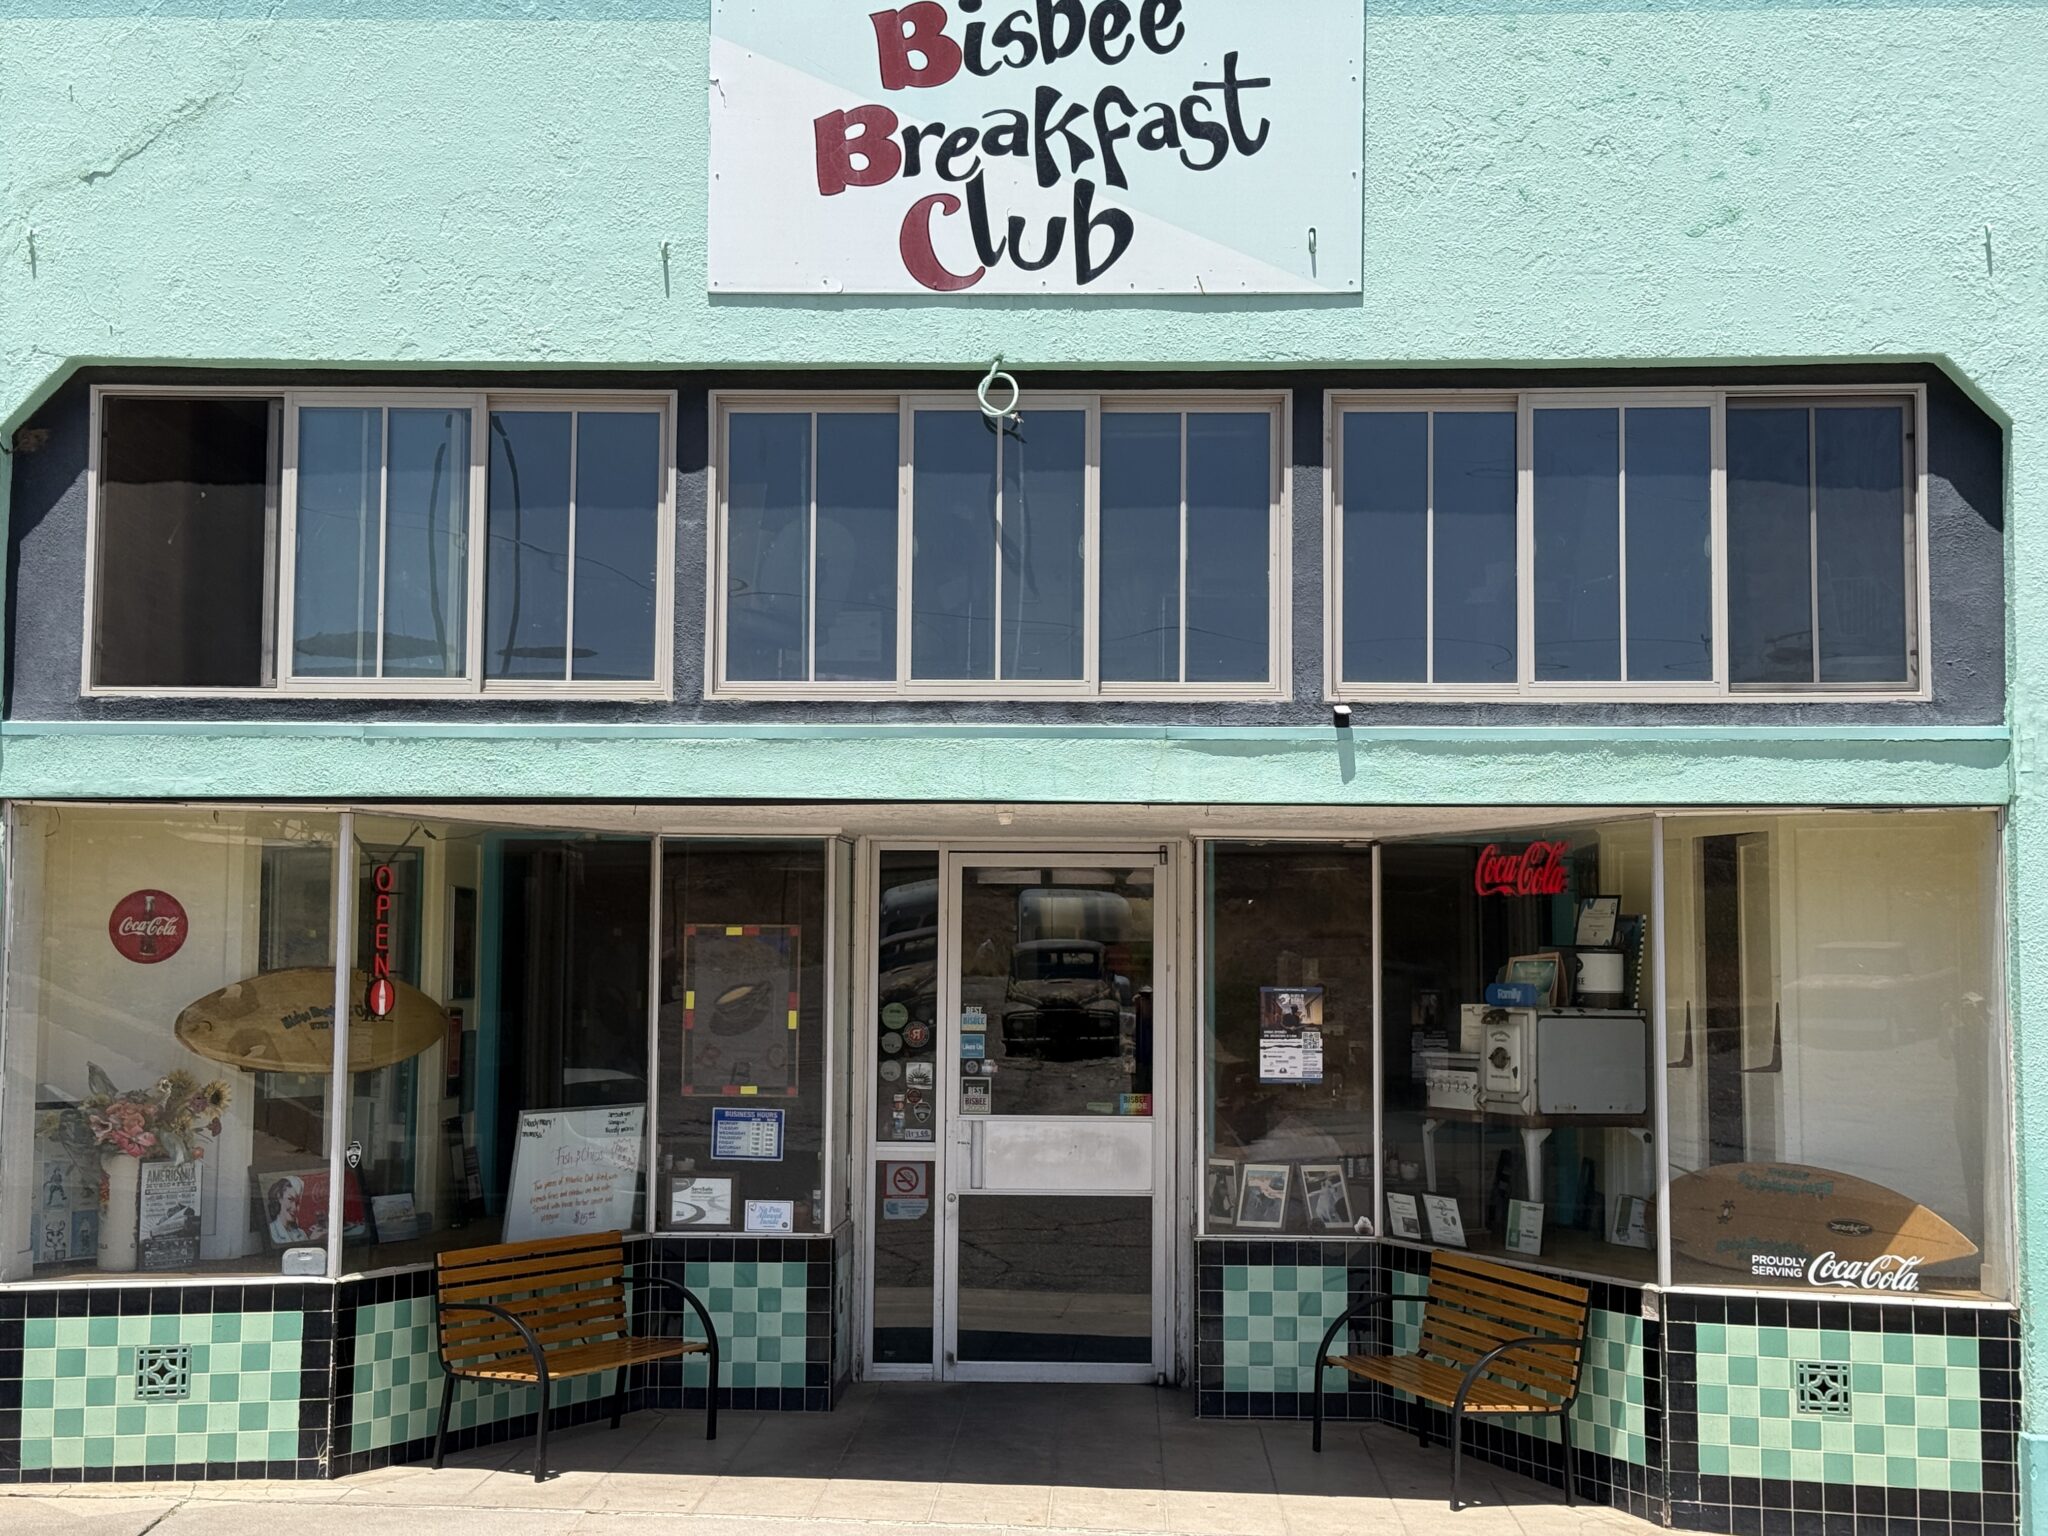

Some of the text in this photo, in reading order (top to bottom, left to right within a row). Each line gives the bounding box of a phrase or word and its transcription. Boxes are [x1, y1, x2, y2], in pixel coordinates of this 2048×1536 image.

[869, 0, 1185, 90] Bisbee
[814, 51, 1271, 196] Breakfast
[900, 169, 1134, 291] Club
[1475, 841, 1571, 896] Coca-Cola
[118, 916, 180, 937] Coca-Cola
[373, 864, 395, 978] OPEN
[965, 1097, 987, 1106] BISBEE
[968, 1086, 985, 1095] BEST
[756, 1111, 779, 1119] HOURS
[1751, 1254, 1807, 1268] PROUDLY
[1751, 1265, 1803, 1278] SERVING
[1807, 1251, 1926, 1292] Coca-Cola
